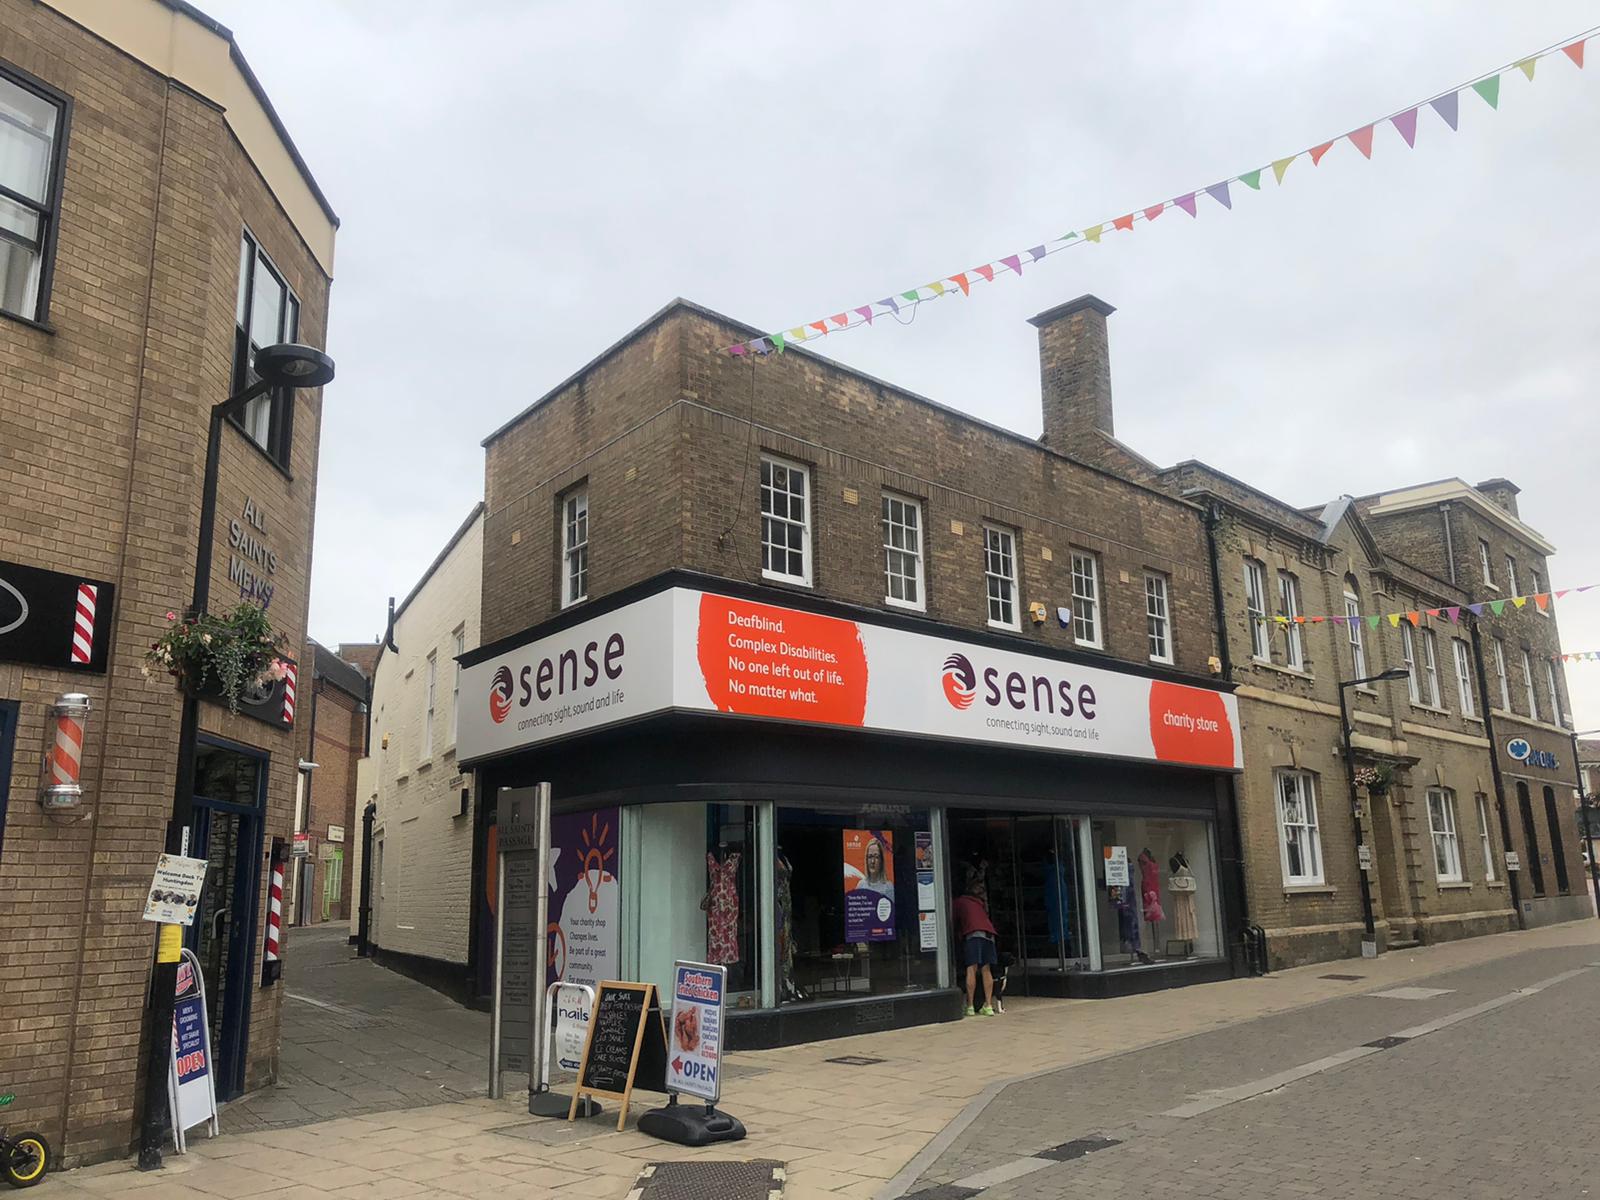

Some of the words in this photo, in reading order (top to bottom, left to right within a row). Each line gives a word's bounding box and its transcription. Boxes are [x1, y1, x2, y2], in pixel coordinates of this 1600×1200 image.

[243, 496, 266, 535] ALL
[229, 520, 277, 575] SAINTS
[229, 554, 274, 602] MEWS
[728, 611, 785, 633] Deafblind.
[728, 633, 777, 654] Complex
[779, 641, 839, 664] Disabilities.
[519, 632, 625, 707] sense
[728, 655, 746, 671] No
[748, 662, 770, 675] one
[772, 661, 791, 678] left
[793, 668, 811, 681] out
[813, 669, 825, 683] of
[826, 670, 845, 686] life.
[728, 679, 746, 694] No
[748, 684, 787, 699] matter
[789, 688, 818, 703] what.
[983, 667, 1097, 720] sense
[517, 713, 554, 732] connecting
[573, 698, 595, 715] sound
[595, 692, 611, 709] and
[612, 688, 625, 704] life
[1163, 709, 1195, 733] charity
[1196, 717, 1218, 732] store
[986, 716, 1030, 735] connecting
[1051, 724, 1073, 737] sound
[1074, 727, 1087, 739] and
[1088, 728, 1100, 741] life
[156, 870, 181, 878] Welcome
[162, 877, 194, 886] Huntingdon
[570, 917, 579, 926] Your
[580, 917, 595, 928] charity
[595, 918, 606, 928] shop
[569, 931, 587, 942] Changes
[569, 946, 575, 955] Be
[575, 947, 585, 956] part
[585, 947, 591, 955] of
[594, 948, 607, 958] great
[684, 971, 713, 987] Southern
[558, 1008, 589, 1021] nails
[177, 1049, 206, 1077] OPEN
[683, 1060, 716, 1082] OPEN
